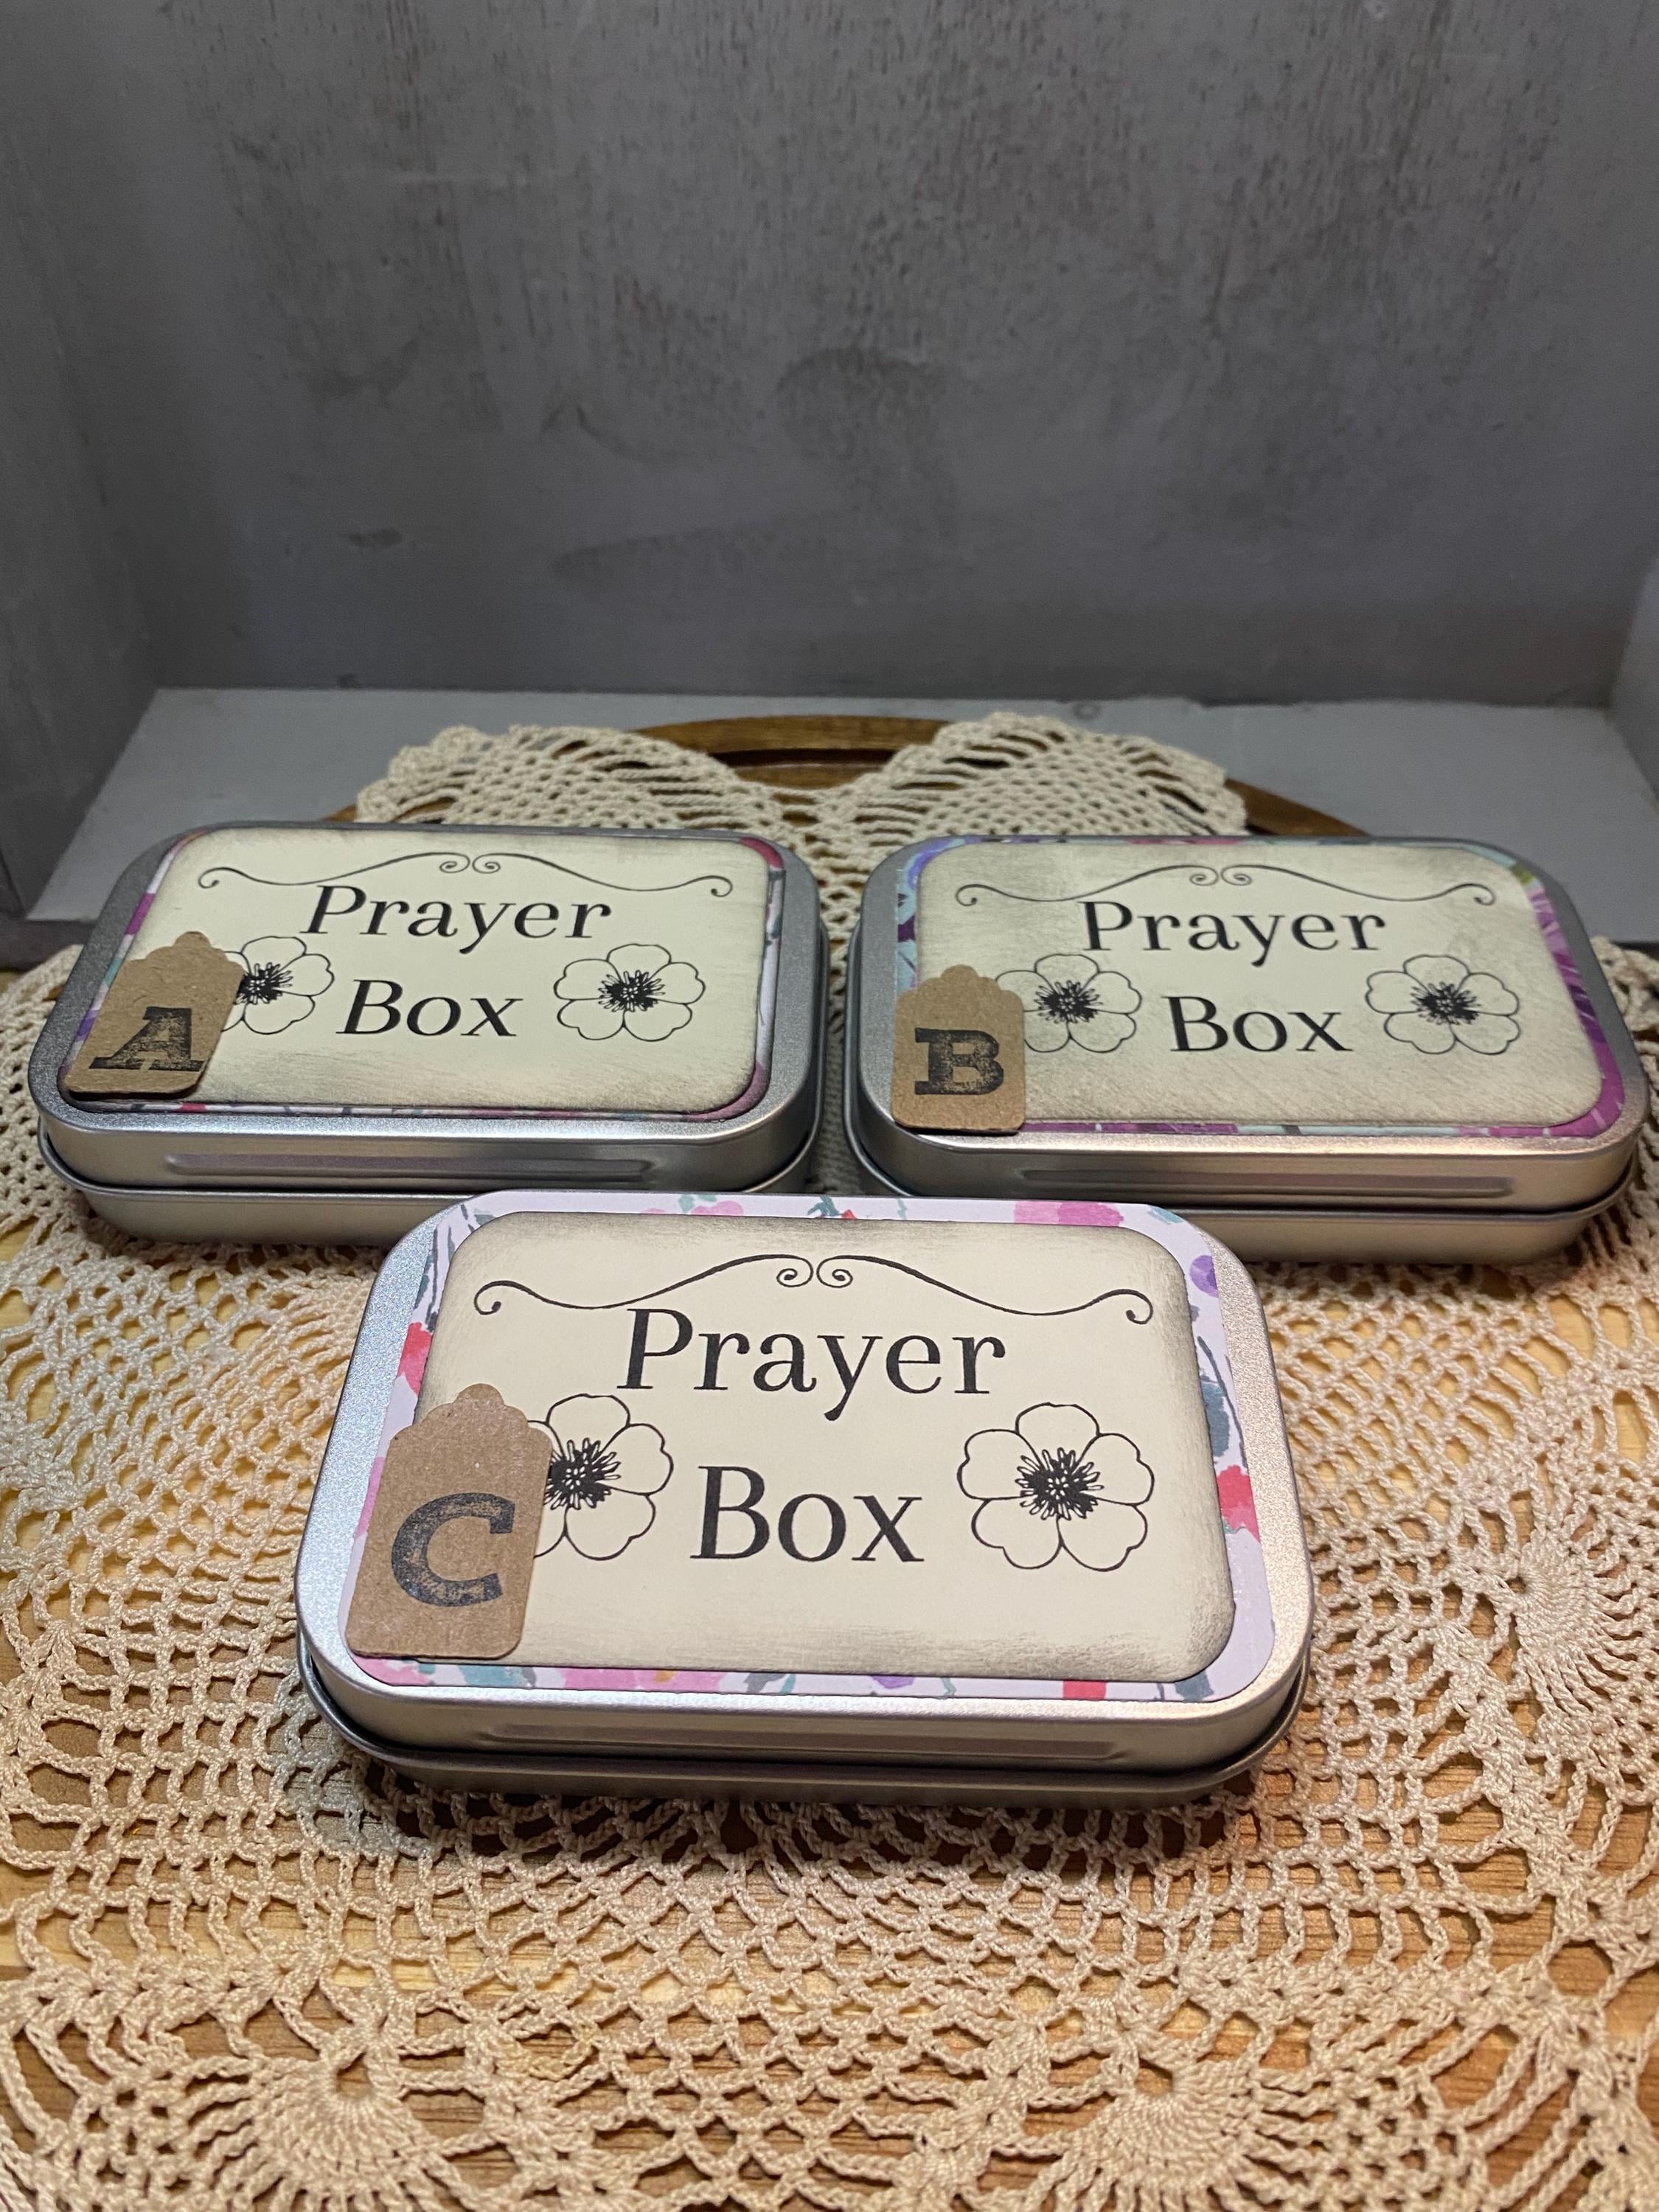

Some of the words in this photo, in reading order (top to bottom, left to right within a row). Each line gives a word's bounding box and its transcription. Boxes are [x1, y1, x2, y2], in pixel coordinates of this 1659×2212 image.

[299, 884, 612, 954] Prayer
[1079, 900, 1386, 967] Prayer
[88, 1006, 205, 1072] A
[336, 979, 524, 1037] Box
[1162, 995, 1354, 1053] Box
[914, 1026, 1005, 1096] B
[616, 1307, 1006, 1422] Prayer
[689, 1465, 925, 1562] Box
[390, 1492, 515, 1607] C
